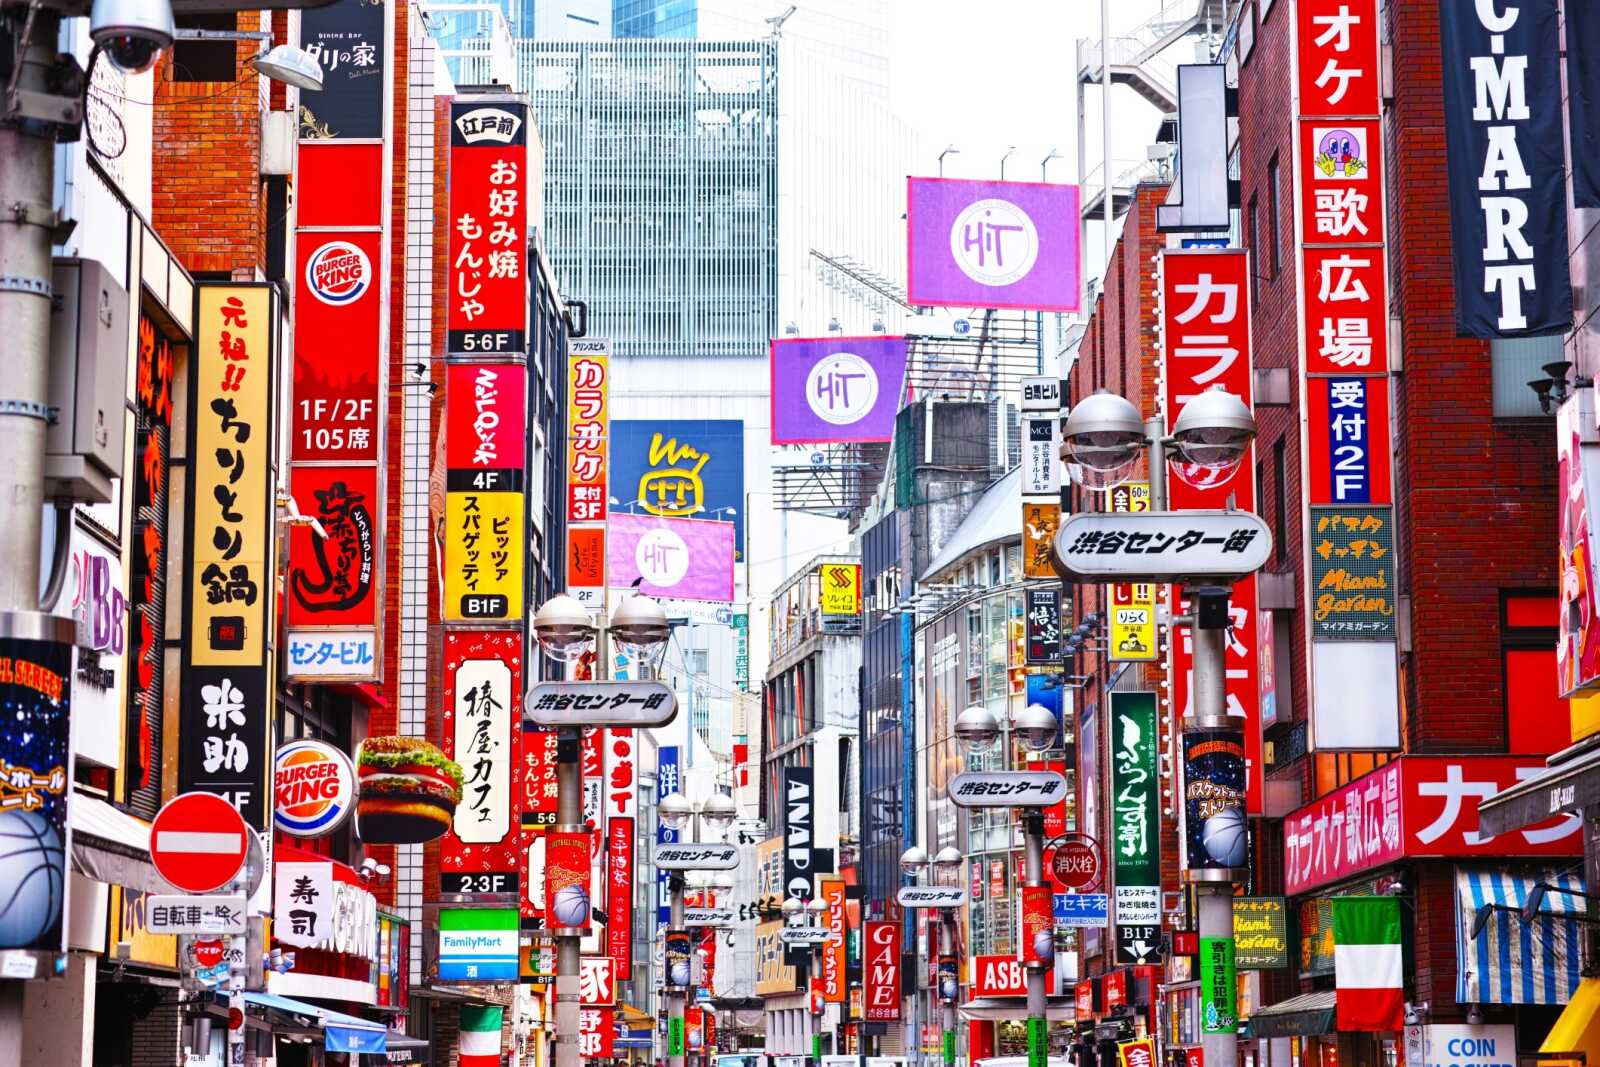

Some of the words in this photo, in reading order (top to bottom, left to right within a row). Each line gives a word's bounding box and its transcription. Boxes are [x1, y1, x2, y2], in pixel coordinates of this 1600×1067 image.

[463, 116, 515, 136] 江戸前
[488, 159, 519, 280] お好み焼
[315, 254, 361, 277] BURGER
[455, 213, 485, 322] もんじゃ
[317, 264, 363, 292] KING
[572, 342, 606, 352] プリンスビル
[573, 359, 605, 483] カラオケ
[1030, 426, 1052, 435] MCC
[302, 428, 370, 450] 105席
[472, 472, 498, 489] 4F
[200, 398, 258, 606] ちりとり鍋
[573, 487, 601, 501] 受付
[573, 502, 601, 519] 3F
[462, 496, 481, 591] スパゲッティ
[491, 517, 510, 582] ピッツァ
[1068, 530, 1260, 555] 渋谷センター街
[1319, 568, 1386, 591] Miami
[467, 599, 500, 615] B1F
[578, 591, 592, 601] 2F
[1321, 621, 1389, 631] マイアミガーデン
[289, 640, 373, 666] センタービル
[534, 693, 668, 711] 渋谷センター街
[201, 678, 249, 774] 米助
[463, 680, 503, 823] 椿屋カフェ
[275, 763, 338, 791] BURGER
[524, 751, 540, 810] もんじゃ
[957, 781, 1061, 796] 渋谷センター街
[275, 777, 340, 810] KING
[787, 779, 810, 870] ANAP
[1286, 767, 1401, 887] カラオケ歌広場
[657, 850, 735, 862] 渋谷センター街
[1056, 855, 1094, 873] 消火栓
[902, 892, 963, 900] 渋谷センター街
[1117, 889, 1158, 897] レモンステーキ
[152, 904, 242, 928] 自転車除く
[289, 875, 319, 937] 寿司
[444, 936, 502, 948] FamilyMart
[612, 931, 626, 940] 2F
[825, 890, 844, 995] プリクラのメッカ
[1122, 928, 1154, 940] B1F
[466, 965, 478, 978] 酒
[871, 924, 895, 1006] GAME
[984, 961, 1029, 990] ASB
[1447, 1038, 1496, 1057] COIN
